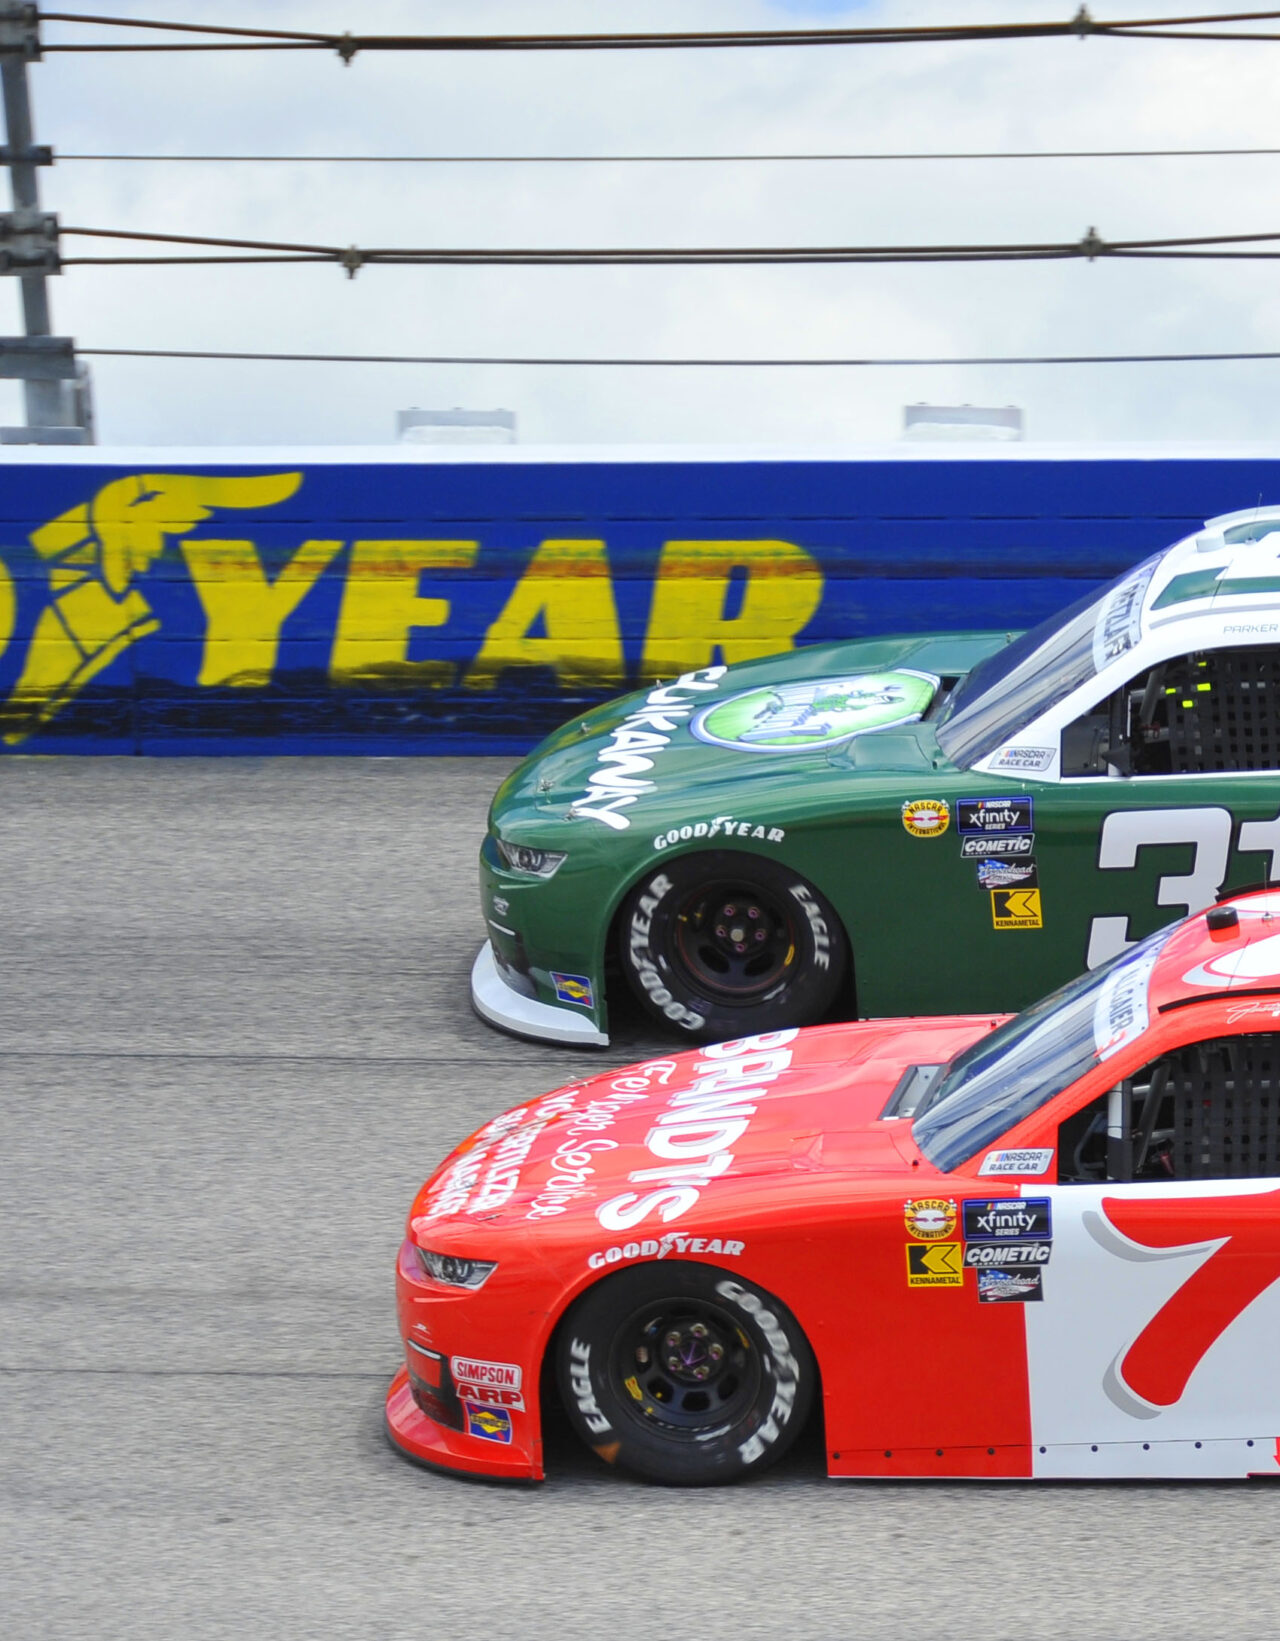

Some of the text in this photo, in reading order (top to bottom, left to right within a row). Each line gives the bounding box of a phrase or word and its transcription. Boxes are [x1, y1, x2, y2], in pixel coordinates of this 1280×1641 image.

[1223, 623, 1279, 635] PARKER
[1013, 749, 1046, 760] NASCAR
[998, 758, 1042, 768] RACE CAR
[908, 801, 943, 813] NASCAR
[984, 800, 1012, 809] NASCAR
[969, 809, 1020, 827] xfinity
[984, 823, 1006, 831] SERIES
[963, 836, 1032, 852] COMETIC
[788, 884, 841, 972] EAGLE
[995, 919, 1040, 928] KENNAMETAL
[1004, 1151, 1043, 1161] NASCAR
[988, 1162, 1039, 1171] RACE CAR
[910, 1201, 951, 1213] NASCAR
[996, 1201, 1027, 1211] NASCAR
[976, 1211, 1037, 1232] xfinity
[994, 1228, 1020, 1237] SERIES
[587, 1231, 746, 1270] GOODYEAR
[965, 1244, 1050, 1263] COMETIC
[909, 1276, 962, 1285] KENNAMETAL
[457, 1361, 515, 1385] SIMPSON
[570, 1337, 614, 1434] EAGLE
[458, 1384, 522, 1405] ARP
